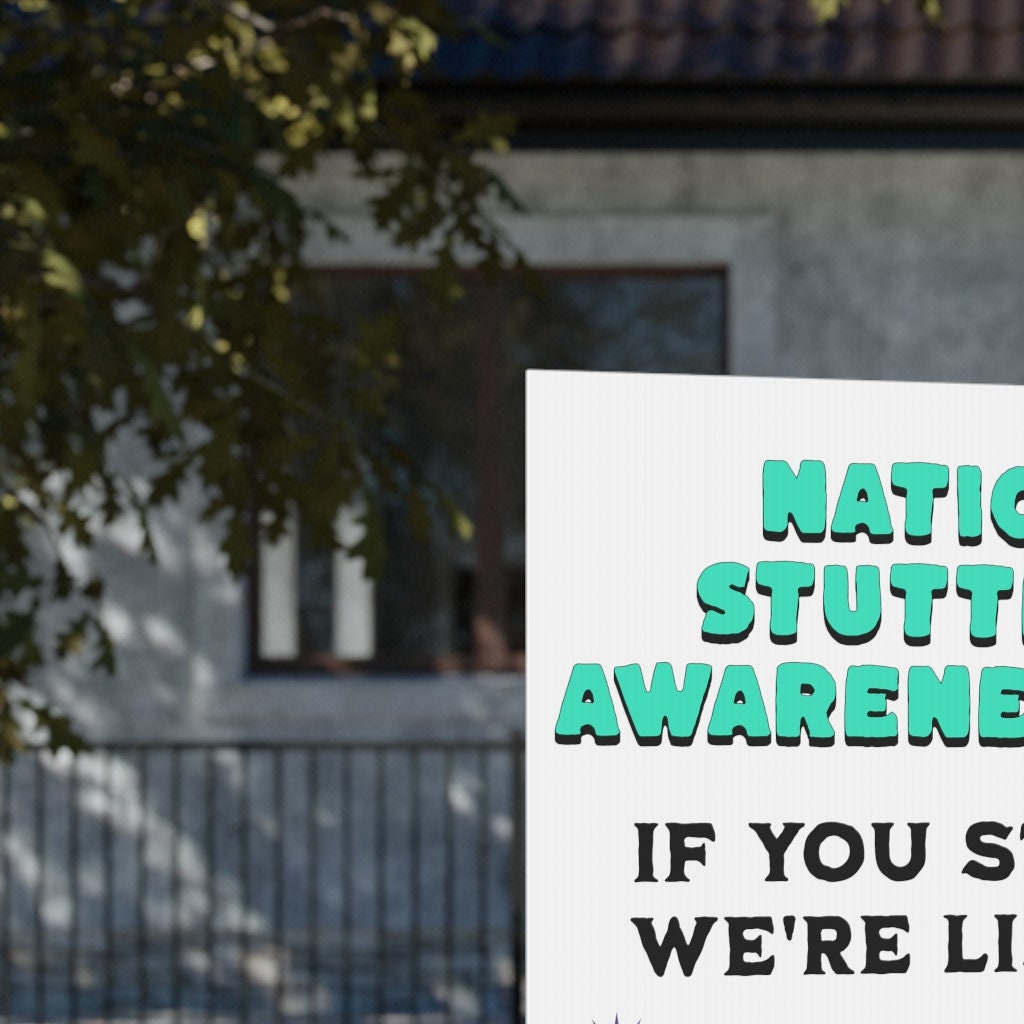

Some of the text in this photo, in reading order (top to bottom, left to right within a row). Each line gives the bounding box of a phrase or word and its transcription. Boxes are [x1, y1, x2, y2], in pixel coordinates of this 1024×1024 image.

[633, 822, 715, 883] IF
[749, 821, 930, 883] YOU
[631, 914, 911, 977] WE'RE
